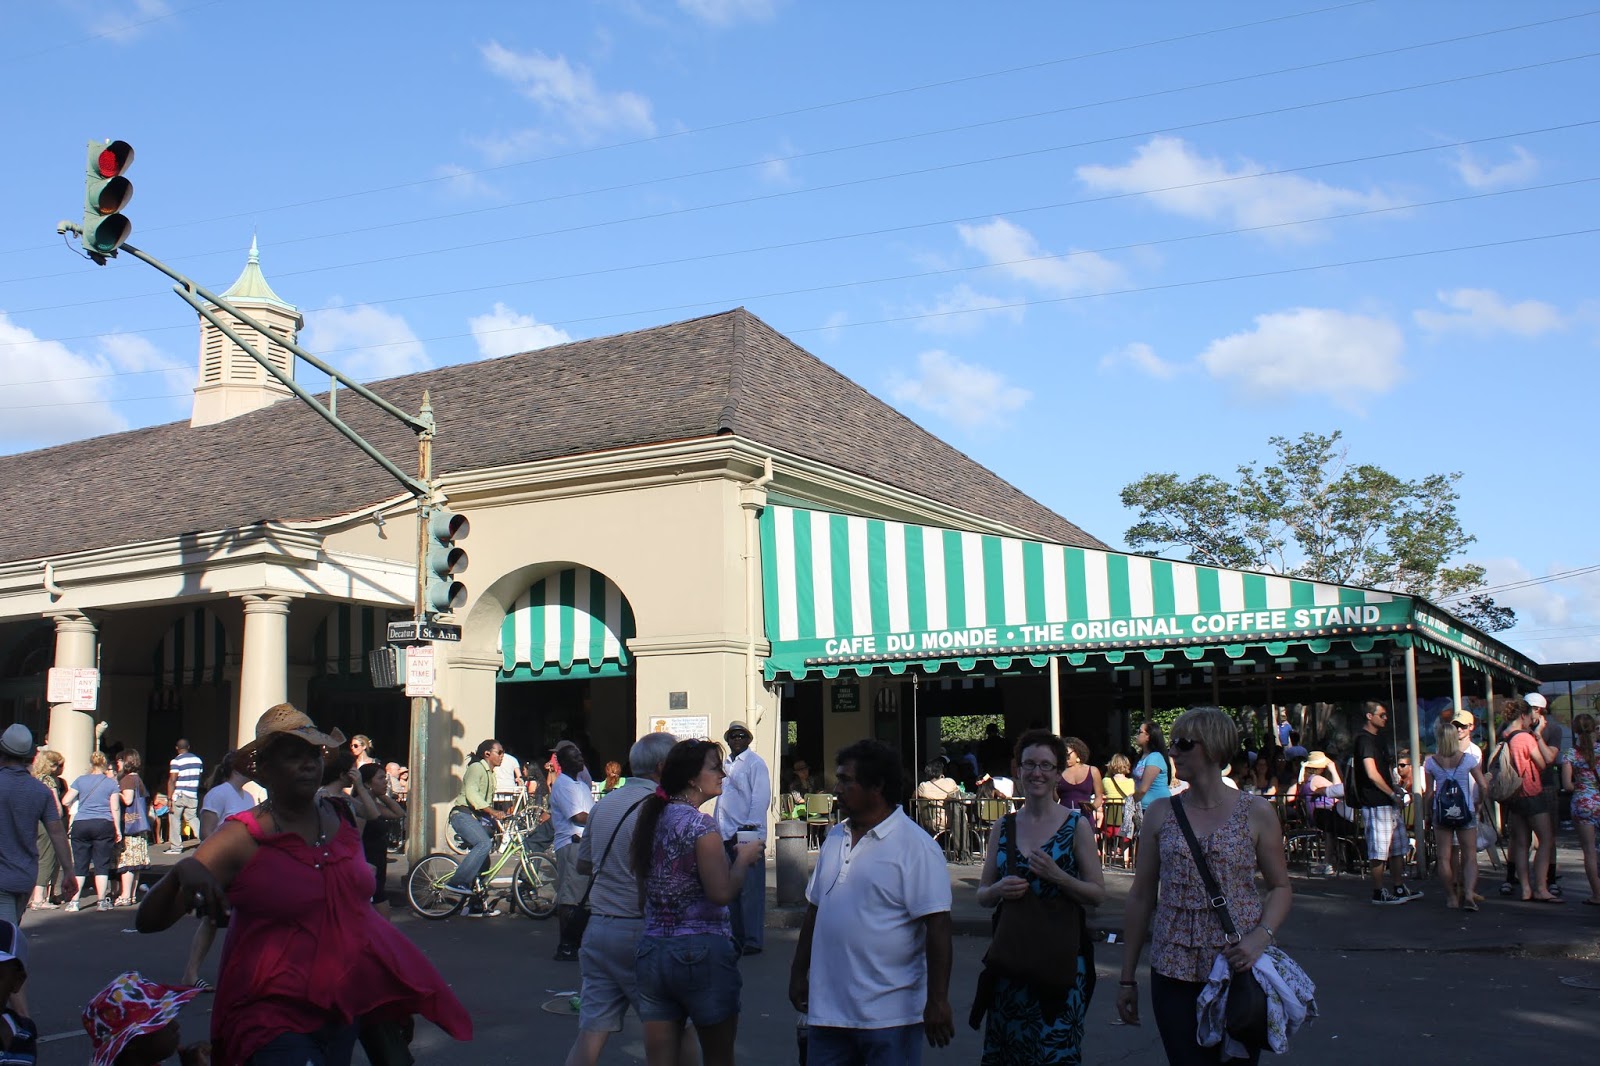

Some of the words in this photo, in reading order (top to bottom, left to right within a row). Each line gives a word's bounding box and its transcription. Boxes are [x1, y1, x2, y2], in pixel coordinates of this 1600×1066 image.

[390, 629, 414, 639] Decatur
[423, 628, 435, 638] St.
[438, 630, 457, 640] Ann
[825, 636, 876, 656] CAFE
[887, 634, 914, 651] DU
[922, 628, 997, 650] MONDE
[1019, 623, 1065, 643] THE
[1071, 617, 1183, 640] ORIGINAL
[1191, 611, 1287, 634] COFFEE
[1293, 605, 1381, 628] STAND
[412, 659, 429, 667] ANY
